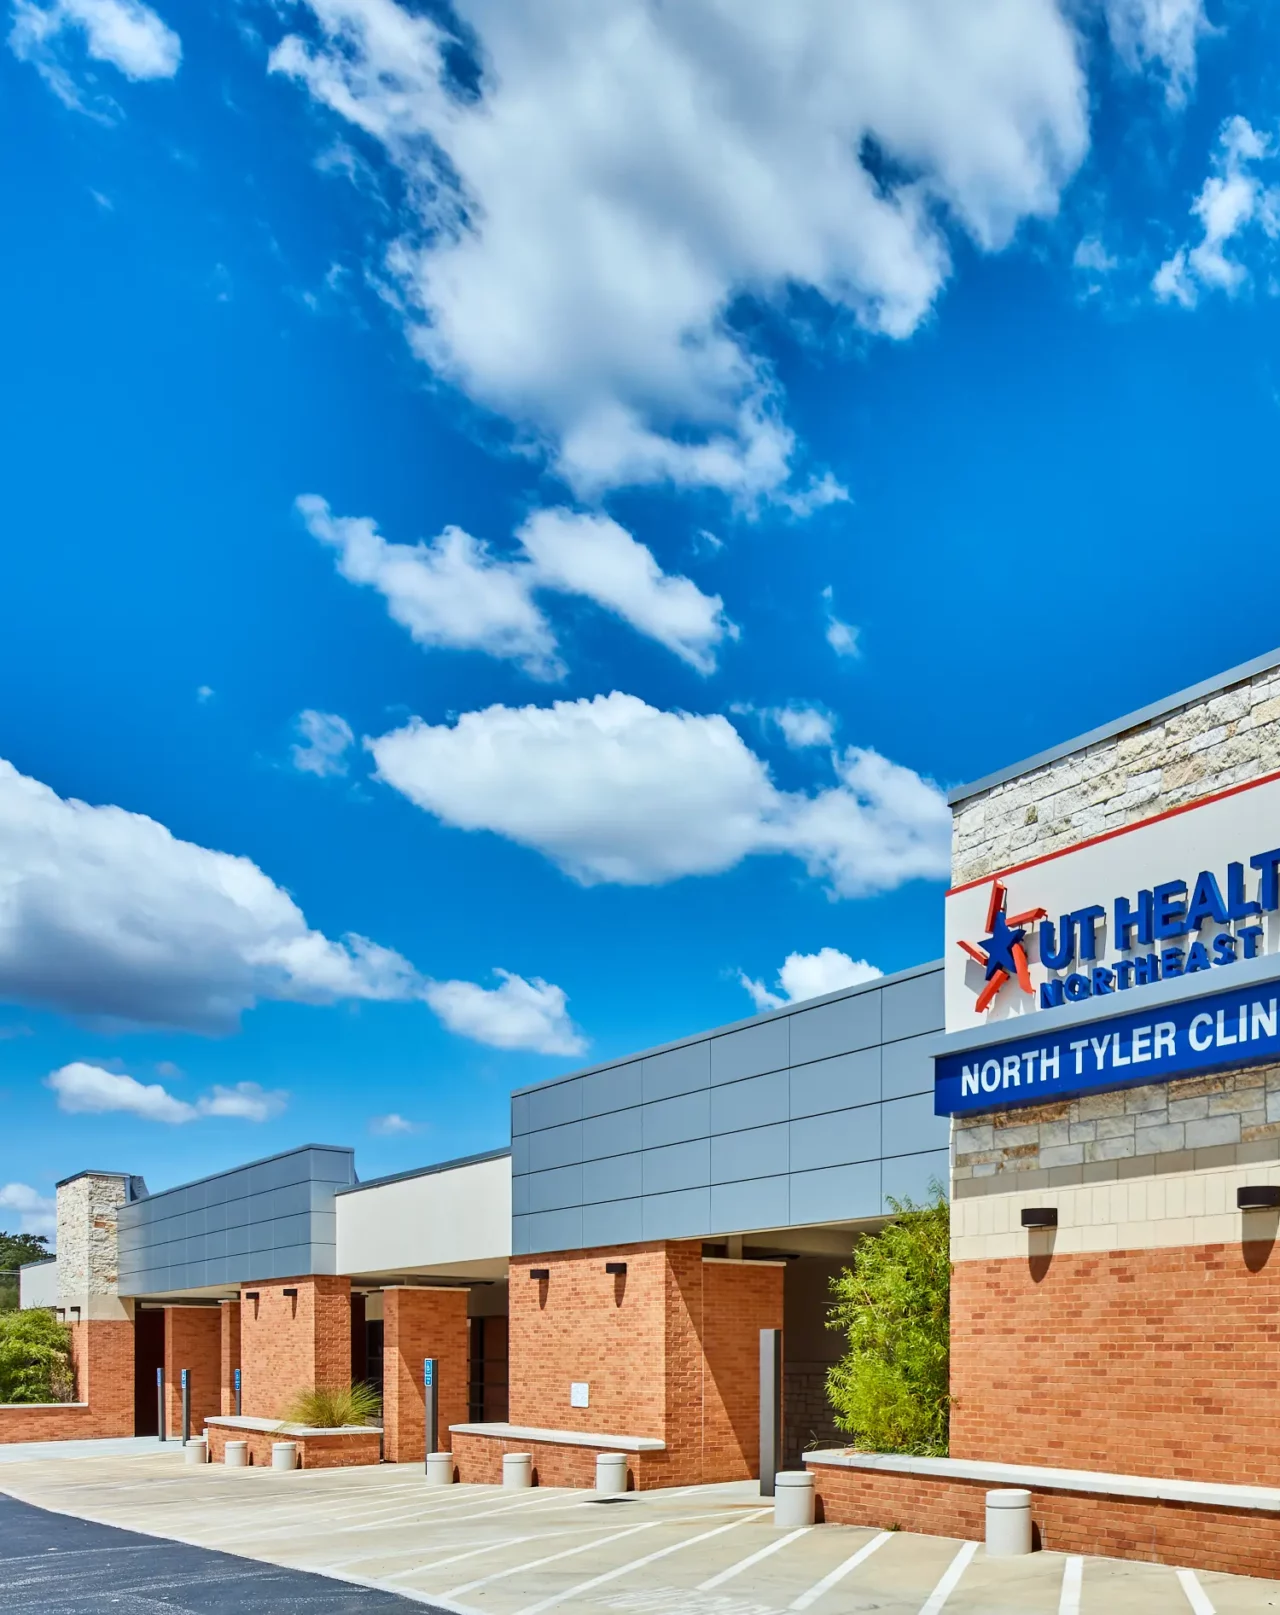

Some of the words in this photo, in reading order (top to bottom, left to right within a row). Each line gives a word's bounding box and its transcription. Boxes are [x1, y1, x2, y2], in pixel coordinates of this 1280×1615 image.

[1039, 904, 1105, 970] UT
[1040, 926, 1264, 1009] NORTHEAST
[960, 1047, 1060, 1097] NORTH
[1069, 1021, 1176, 1075] TYLER
